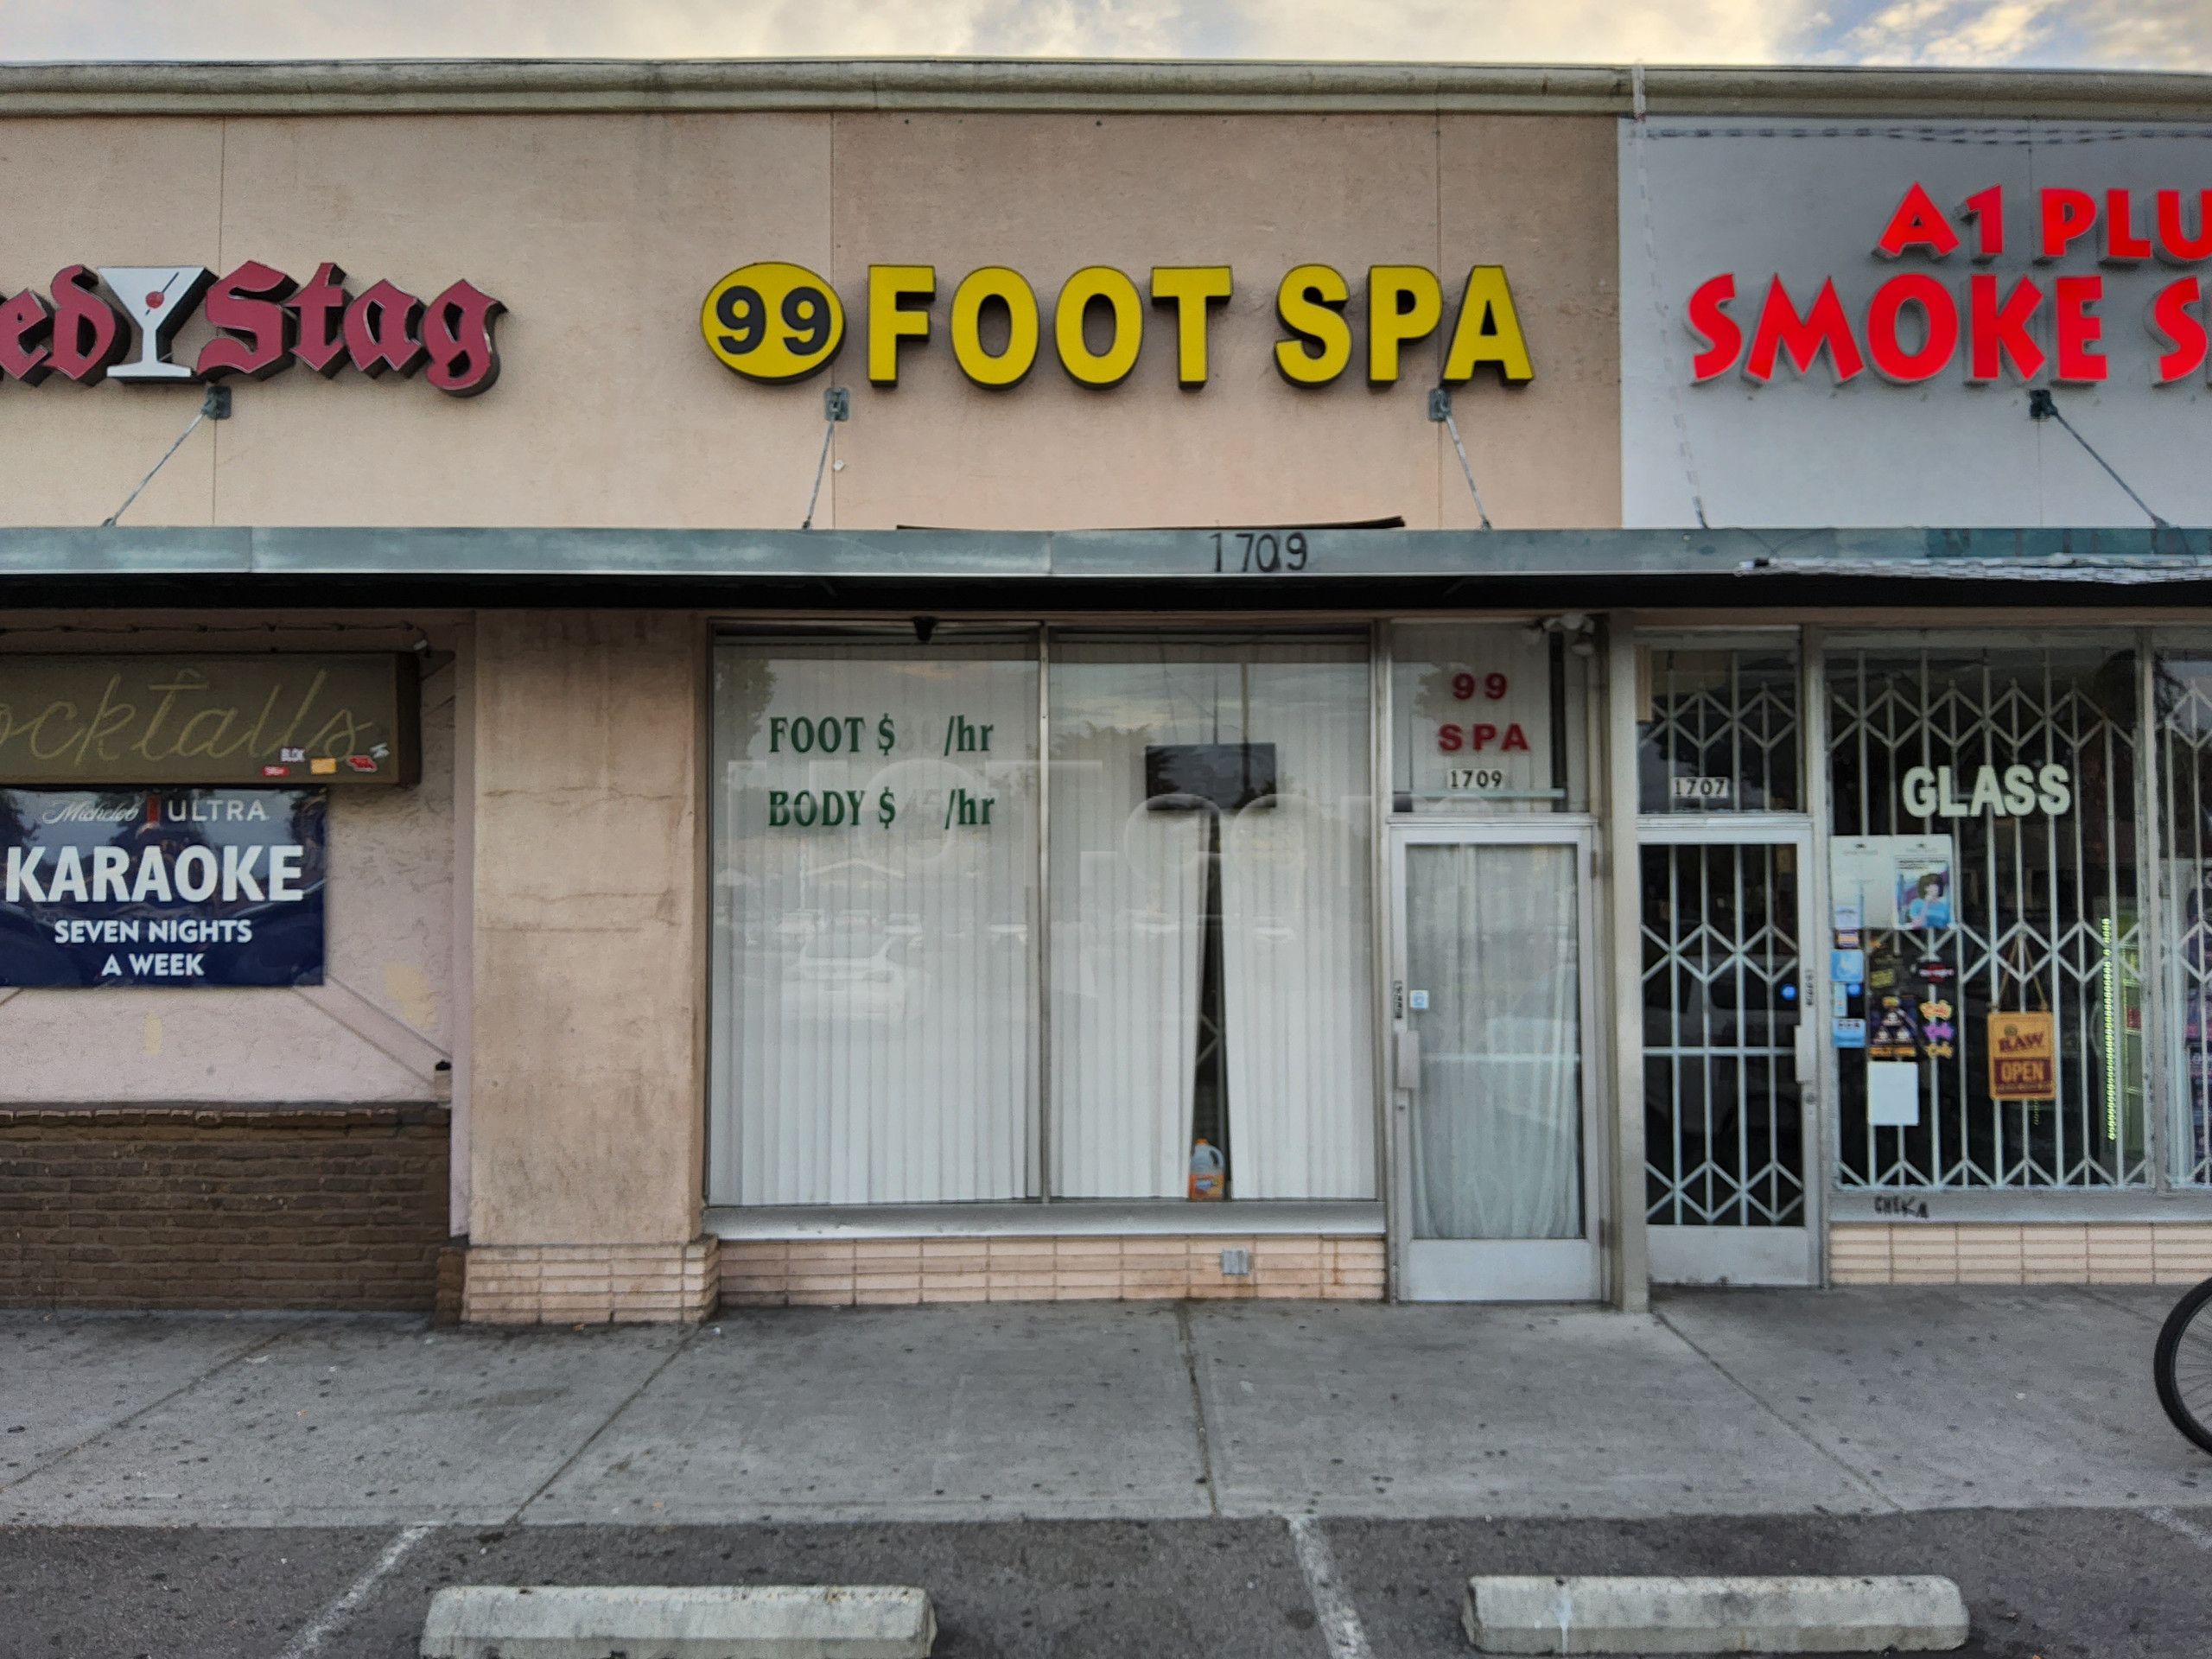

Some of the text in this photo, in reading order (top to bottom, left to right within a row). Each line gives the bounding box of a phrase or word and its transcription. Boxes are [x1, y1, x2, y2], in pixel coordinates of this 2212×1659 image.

[1878, 181, 2212, 261] A1 PLU
[196, 260, 506, 394] Stag
[715, 263, 1535, 388] 99 FOOT SPA
[1687, 271, 2109, 383] SMOKE
[1210, 531, 1307, 573] 1709
[1451, 672, 1509, 700] 99
[768, 715, 866, 753] FOOT
[878, 712, 896, 756] $
[944, 714, 995, 756] /hr
[1438, 722, 1529, 752] SPA
[1450, 769, 1503, 788] 1709
[1674, 778, 1726, 797] 1707
[1902, 763, 2071, 818] GLASS
[42, 799, 267, 824] Michelob ULTRA
[768, 790, 867, 827] BODY
[879, 785, 897, 830] $
[944, 787, 996, 830] /hr
[5, 845, 305, 904] KARAOKE
[54, 919, 253, 944] SEVEN NIGHTS
[101, 953, 205, 977] A WEEK
[1999, 1031, 2044, 1052] RAW
[2001, 1060, 2044, 1083] OPEN
